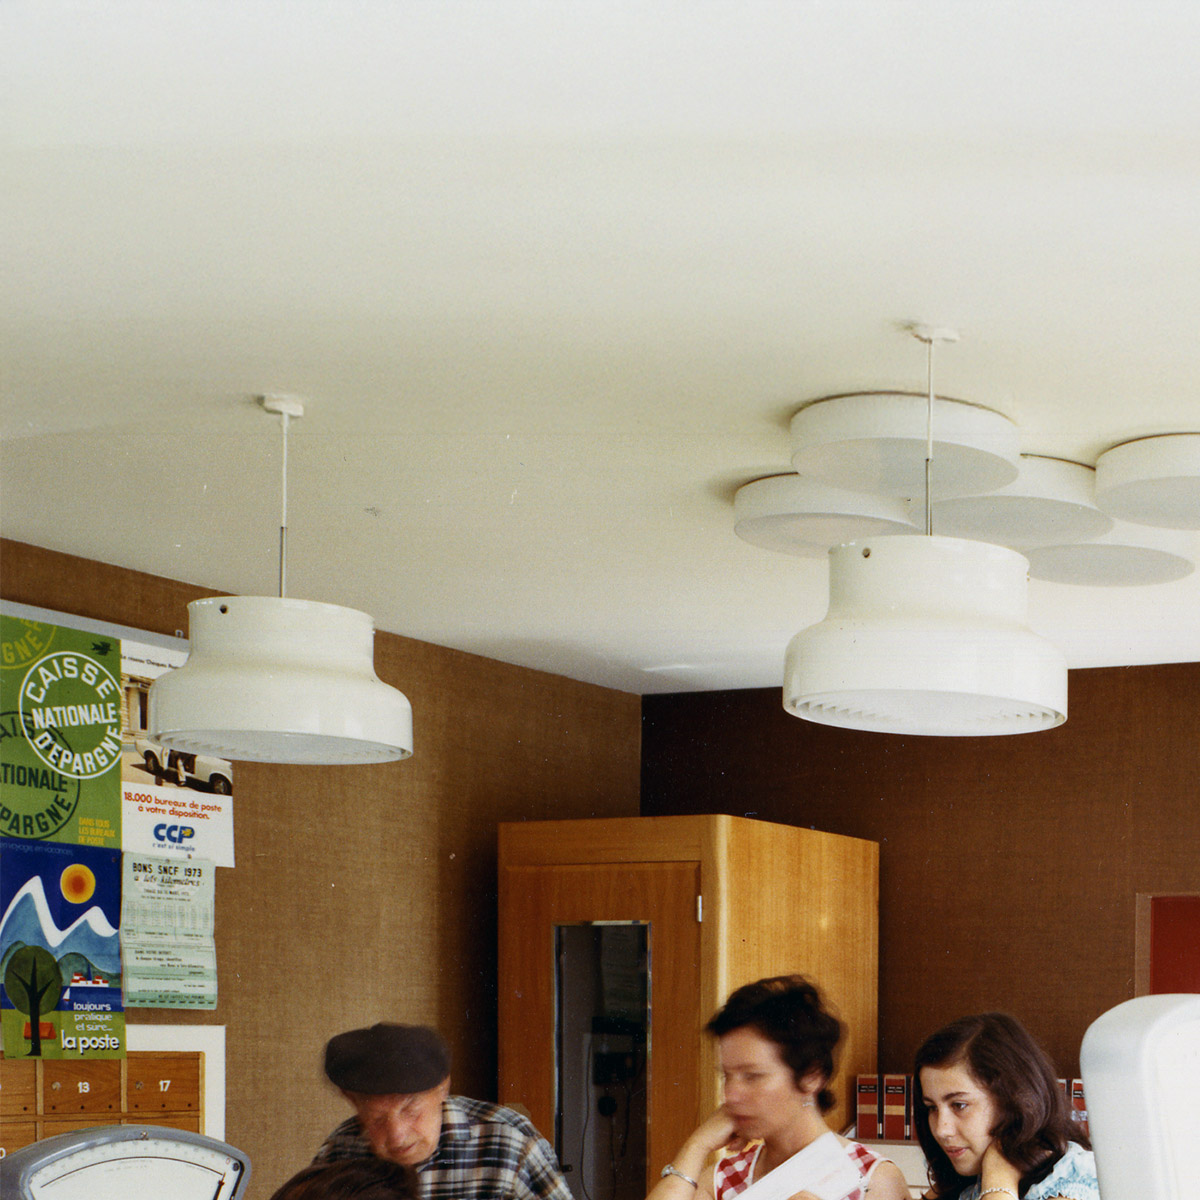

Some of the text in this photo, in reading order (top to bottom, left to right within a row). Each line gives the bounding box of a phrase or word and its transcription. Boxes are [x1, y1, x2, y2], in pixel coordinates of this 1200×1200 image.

[25, 657, 115, 703] CAISSE
[31, 703, 118, 729] NATIONALE
[0, 763, 68, 793] TIONALE
[124, 791, 222, 813] 18.000 bureaux de poste
[145, 805, 167, 815] votre
[168, 807, 210, 820] disposition.
[153, 823, 195, 844] CCP
[132, 862, 203, 878] BONS SNCF 1973
[73, 1002, 111, 1011] toujours
[74, 1012, 113, 1022] pratique
[75, 1022, 85, 1031] et
[61, 1030, 120, 1055] la poste
[77, 1081, 90, 1093] 13
[158, 1080, 171, 1092] 17
